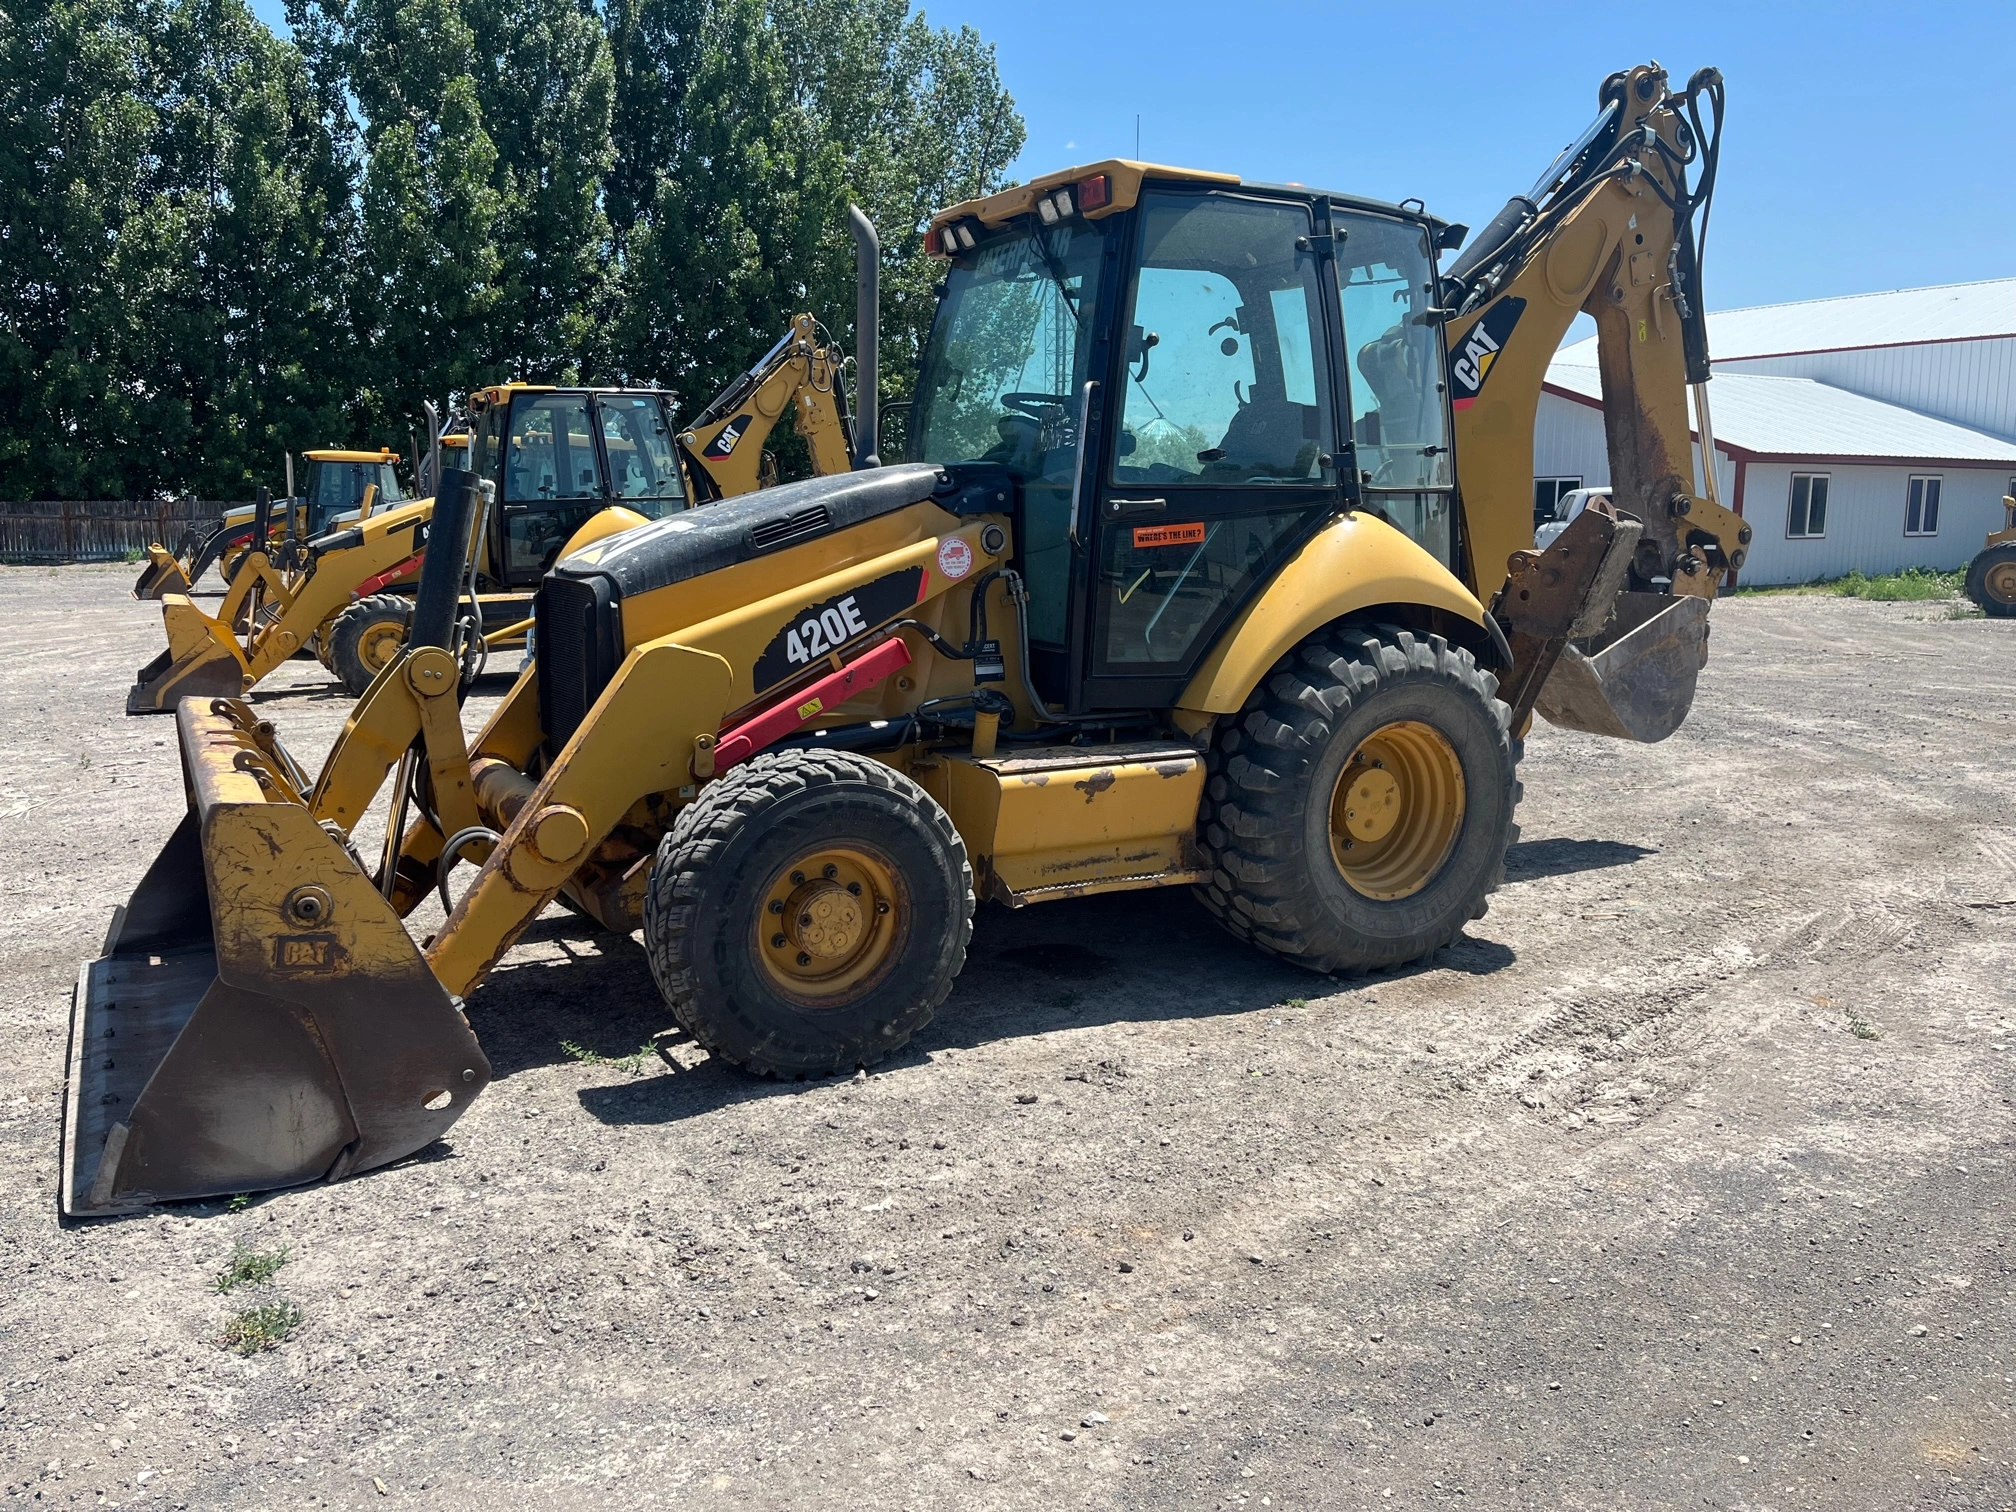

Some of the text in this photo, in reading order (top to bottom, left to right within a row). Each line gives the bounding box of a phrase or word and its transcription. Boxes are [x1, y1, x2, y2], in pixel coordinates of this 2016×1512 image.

[1454, 321, 1500, 391] CAT
[717, 424, 741, 453] CAT
[1169, 530, 1182, 540] THE
[1182, 528, 1202, 539] LINE?
[787, 595, 868, 664] 420E
[284, 941, 329, 966] CAT
